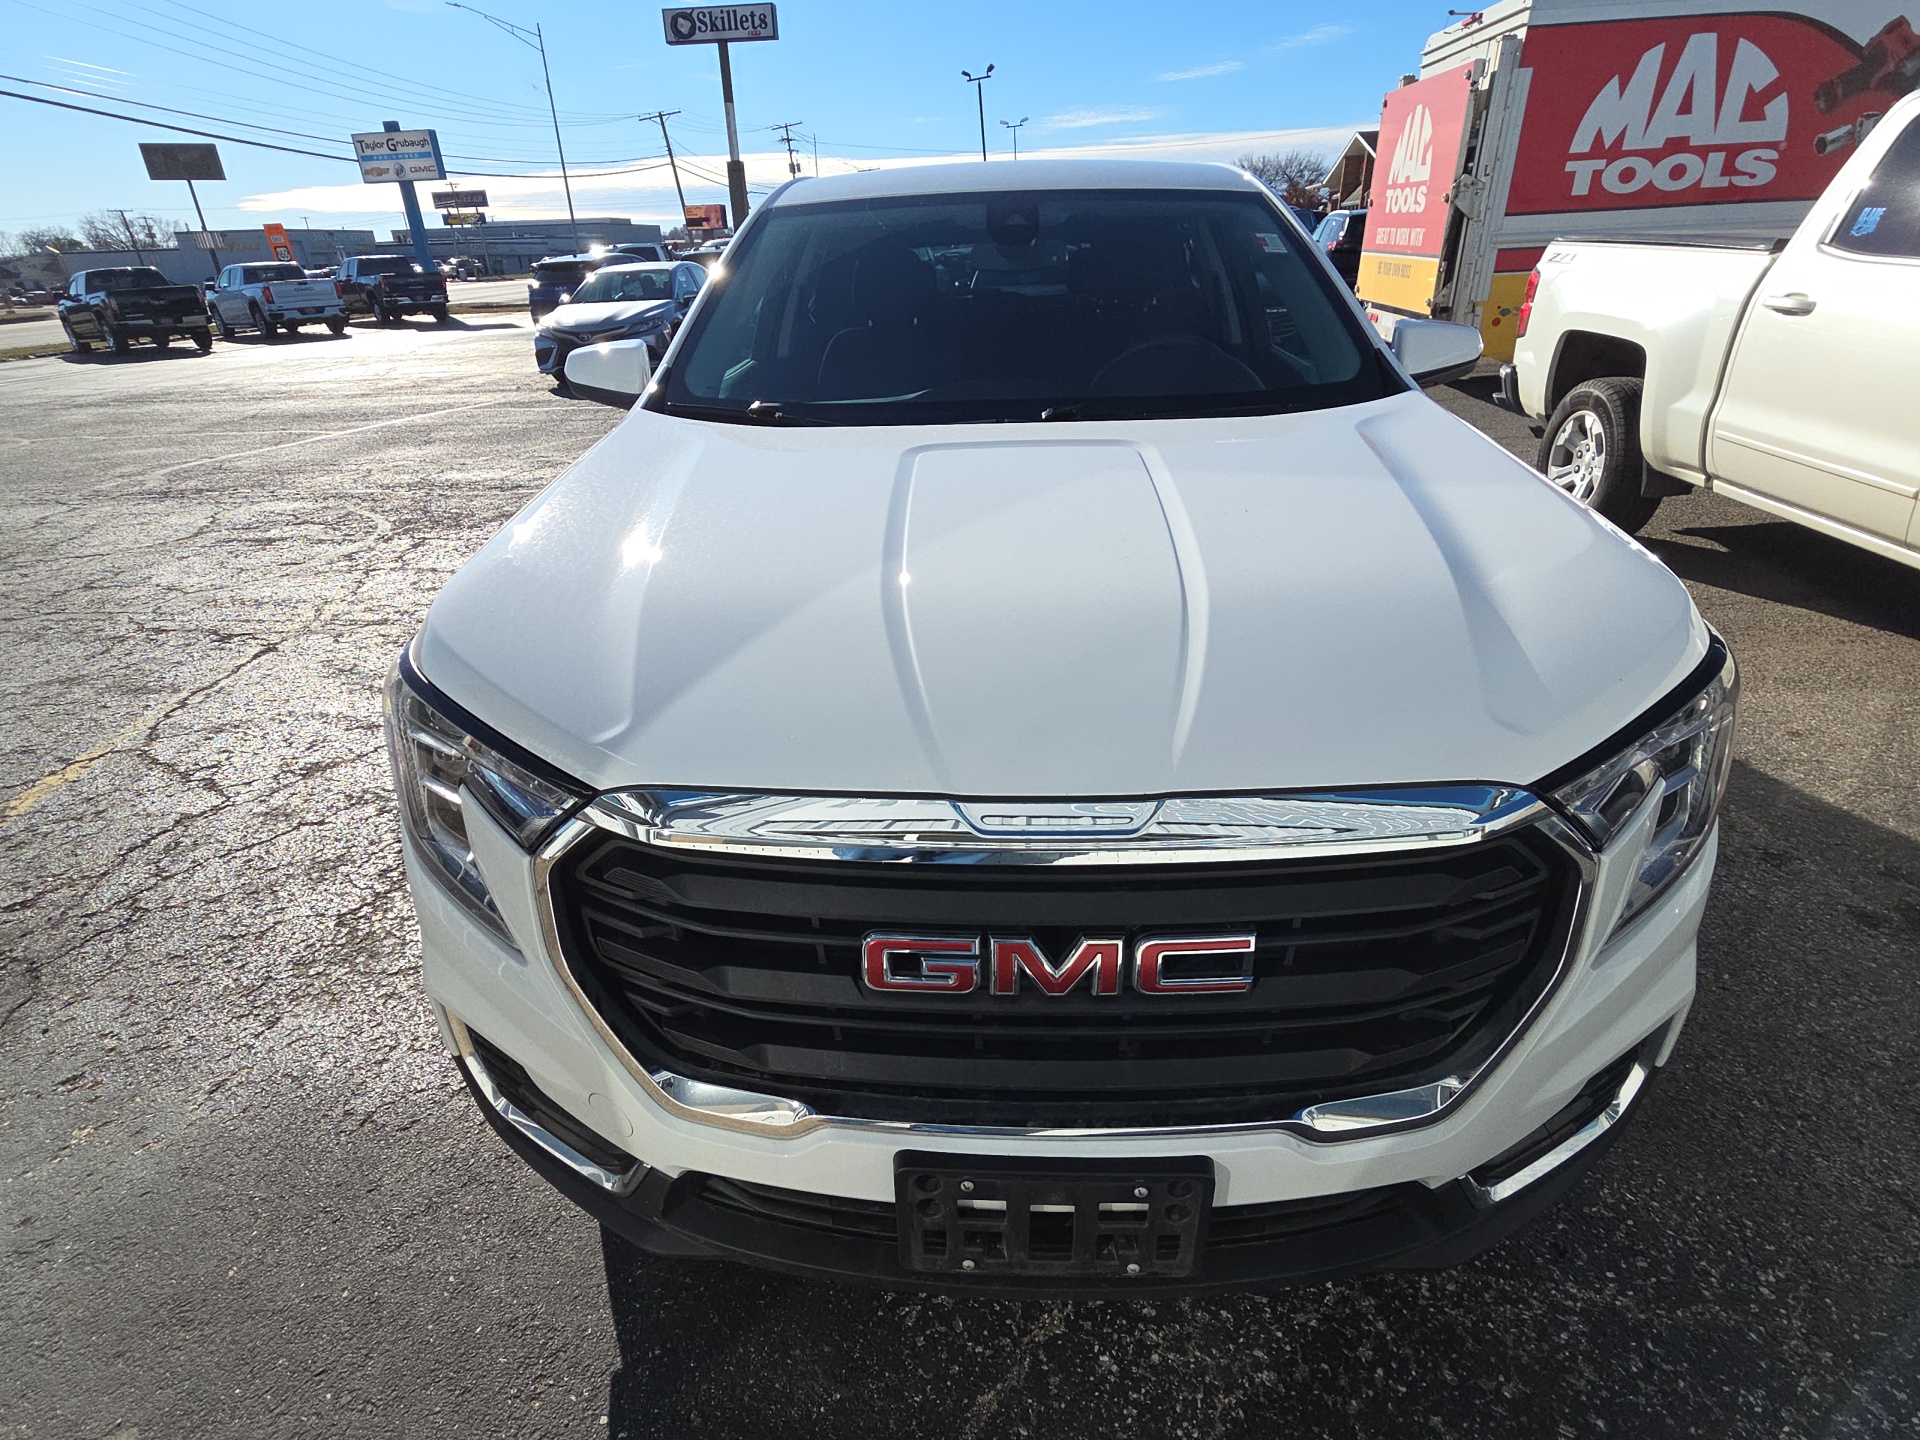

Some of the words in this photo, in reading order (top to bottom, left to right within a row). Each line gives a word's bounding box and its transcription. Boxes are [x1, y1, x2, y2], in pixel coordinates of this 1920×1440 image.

[696, 8, 768, 33] Skillets
[1568, 32, 1789, 154] MAC
[356, 140, 385, 153] Taylor
[386, 137, 429, 152] Grubaugh
[1387, 104, 1433, 185] MAC
[409, 165, 437, 173] GMC
[1564, 148, 1780, 196] TOOLS
[1385, 185, 1428, 214] TOOLS
[1376, 227, 1390, 244] GREAT
[1389, 227, 1396, 245] TO
[1396, 228, 1410, 245] WORK
[1548, 252, 1577, 263] Z71
[861, 930, 1257, 996] GMC
